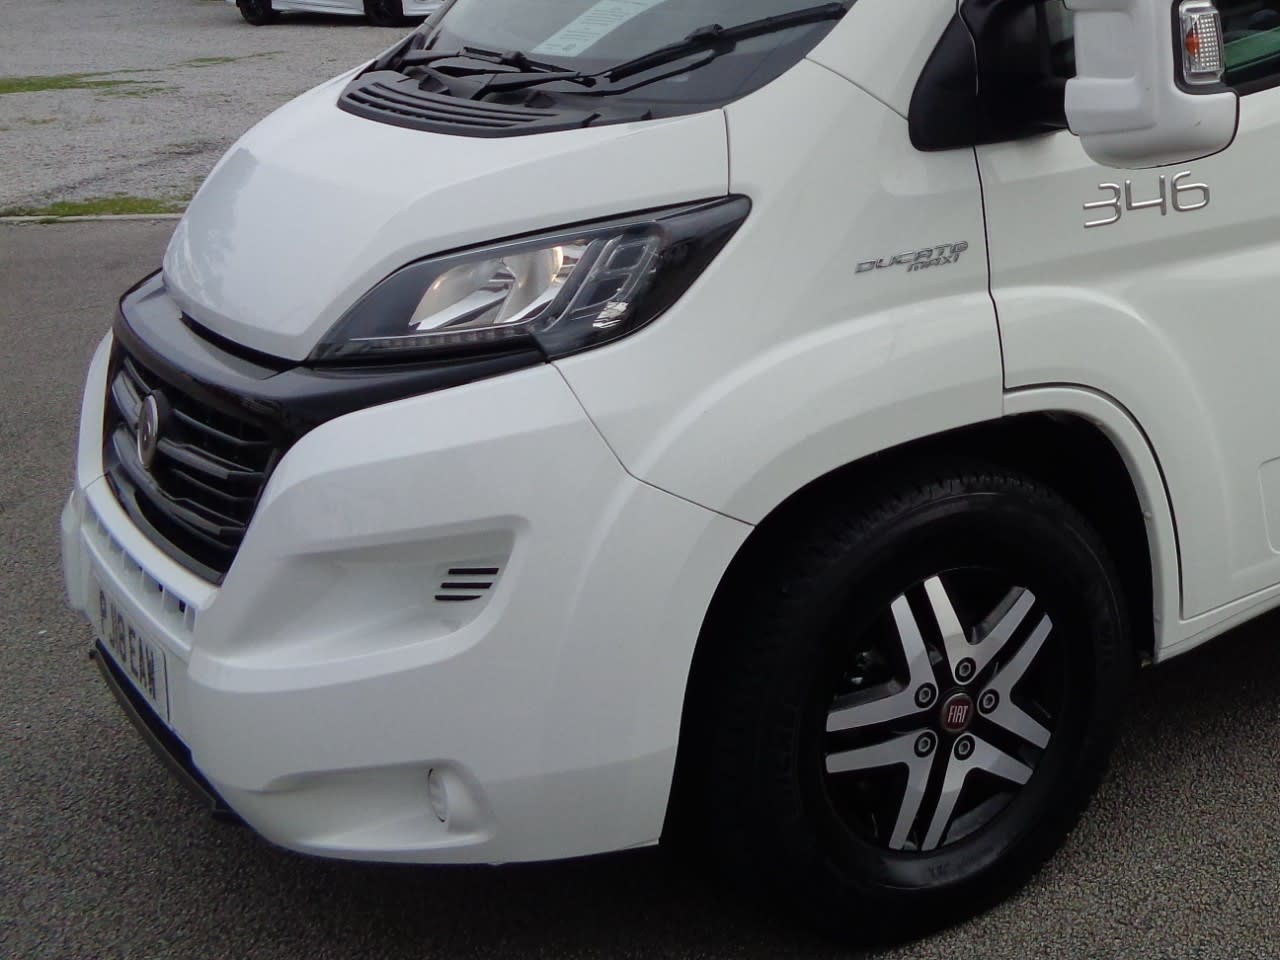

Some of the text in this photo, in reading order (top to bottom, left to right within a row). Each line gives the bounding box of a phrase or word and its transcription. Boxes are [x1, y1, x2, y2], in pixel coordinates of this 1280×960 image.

[1083, 170, 1210, 228] 346
[854, 240, 969, 274] DUCATO
[947, 705, 969, 723] FIAT
